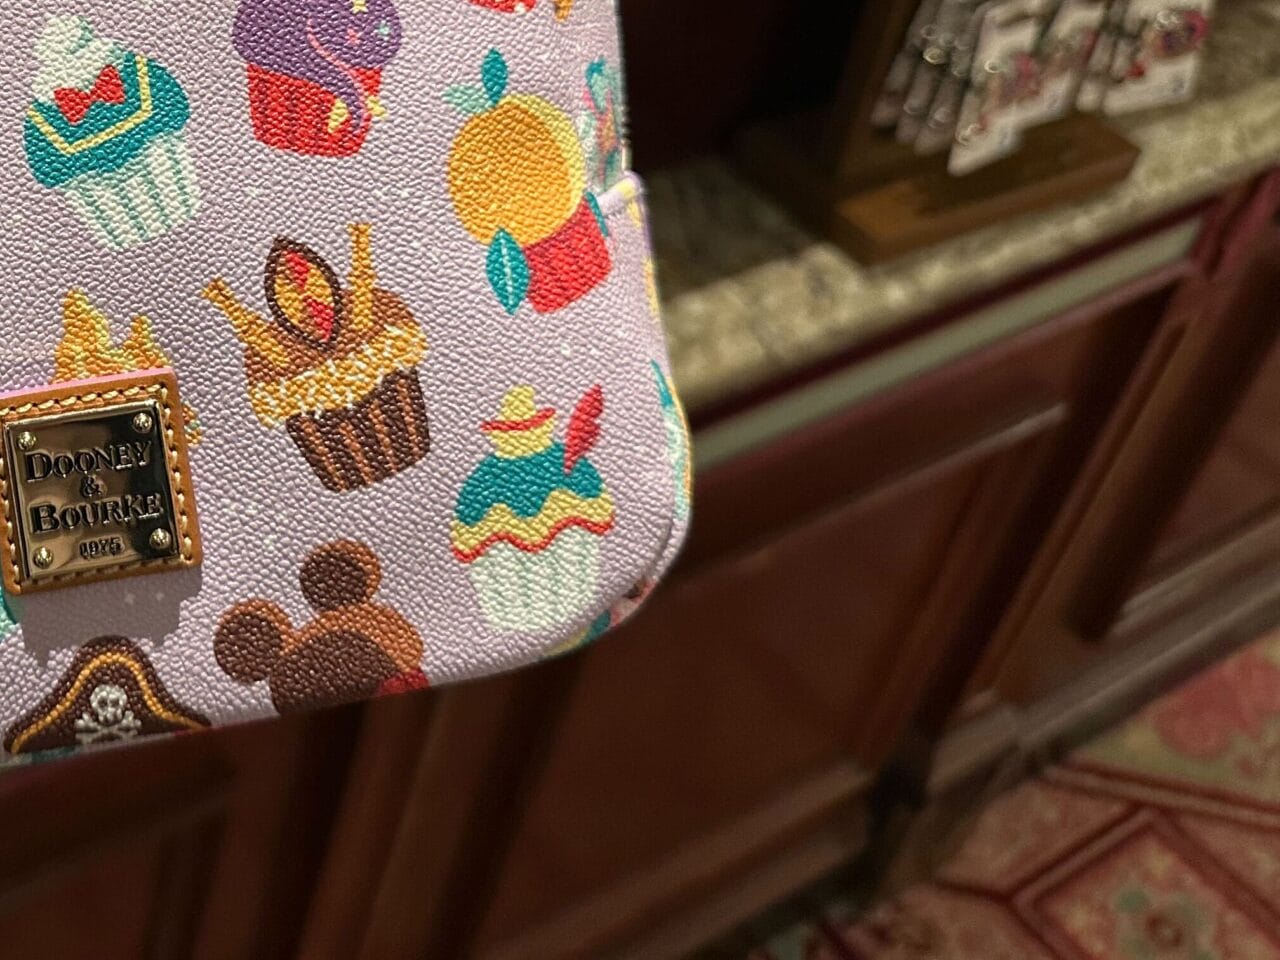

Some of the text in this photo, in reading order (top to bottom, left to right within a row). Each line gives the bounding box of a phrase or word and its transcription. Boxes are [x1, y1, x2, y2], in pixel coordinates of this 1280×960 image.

[25, 441, 151, 482] DOONEY
[81, 475, 103, 497] &
[30, 493, 163, 534] BOURKE
[80, 538, 122, 558] 1975
